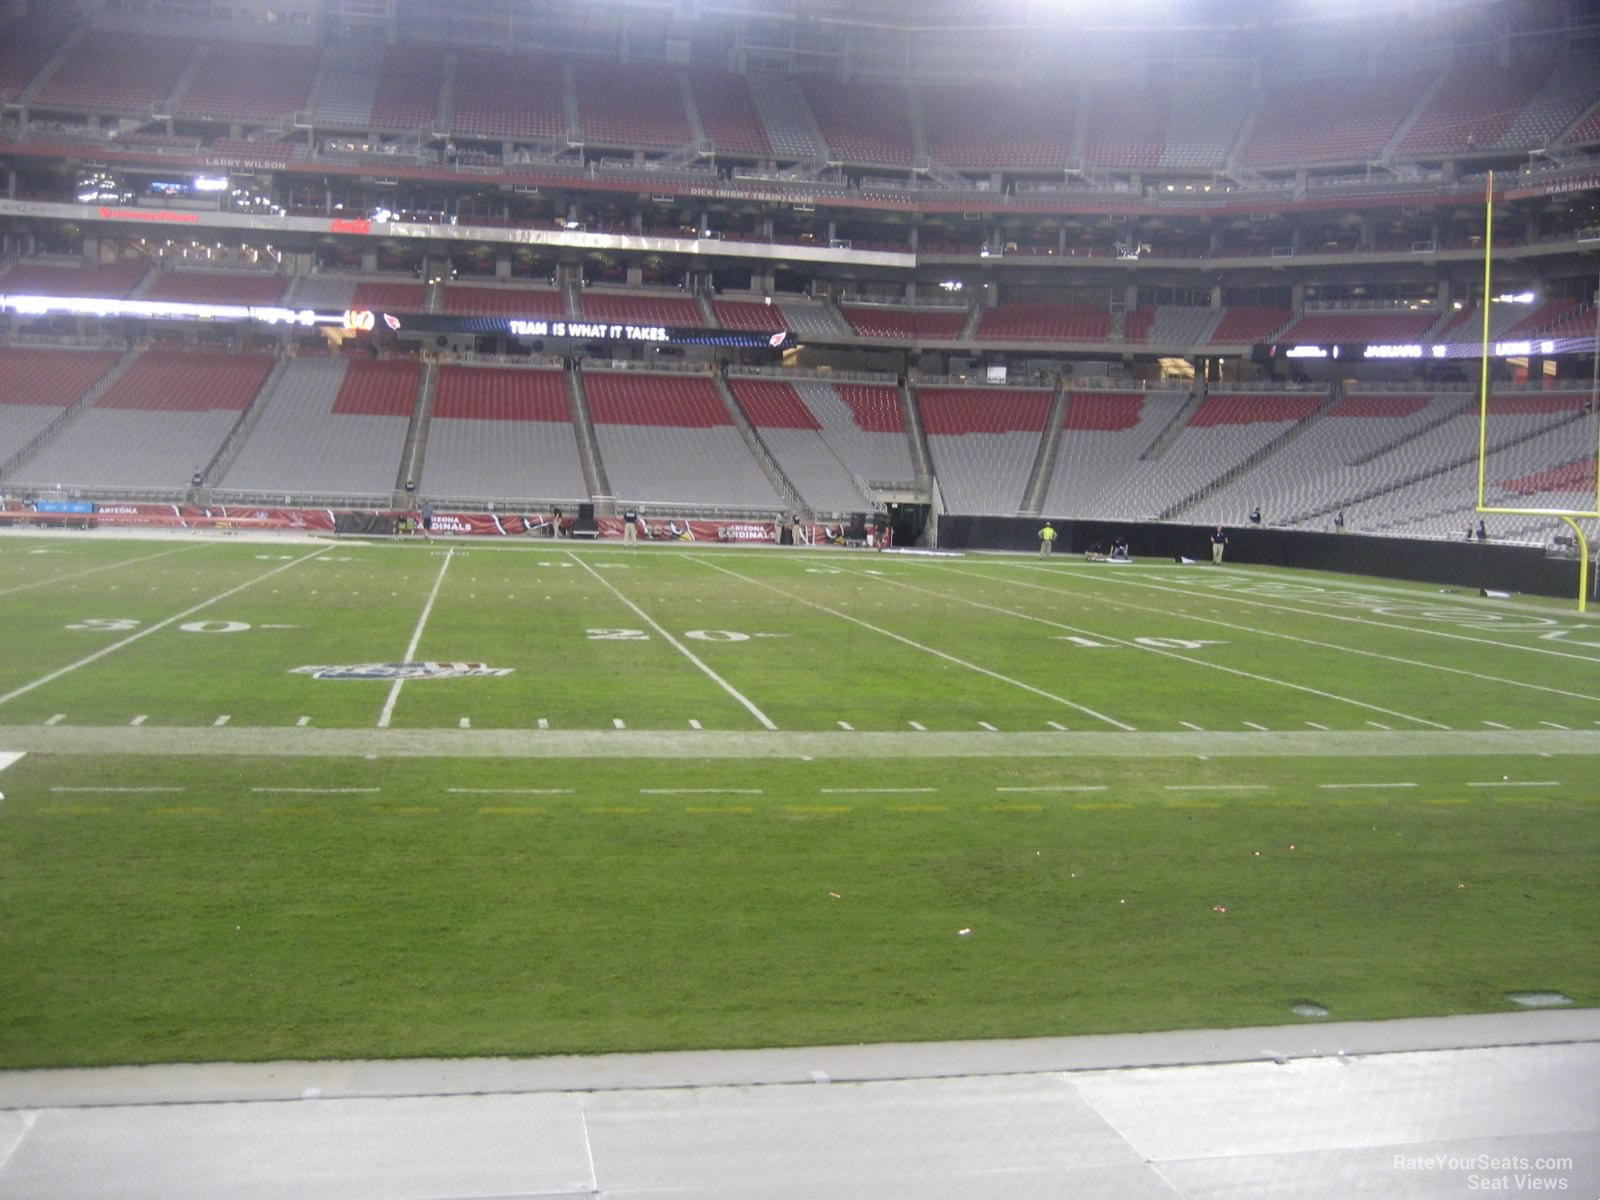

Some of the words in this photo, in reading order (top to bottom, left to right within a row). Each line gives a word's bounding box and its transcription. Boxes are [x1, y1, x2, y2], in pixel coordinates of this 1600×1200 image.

[206, 158, 241, 167] LARRY
[244, 159, 286, 169] WILSON
[1546, 180, 1600, 193] MARSHALL
[690, 187, 713, 196] DICK
[788, 193, 814, 203] LANE
[510, 320, 547, 335] TEAM
[552, 322, 566, 336] IS
[568, 323, 607, 338] WHAT
[610, 325, 622, 338] IT
[625, 326, 670, 341] TAKES.
[416, 522, 472, 531] ADINALS
